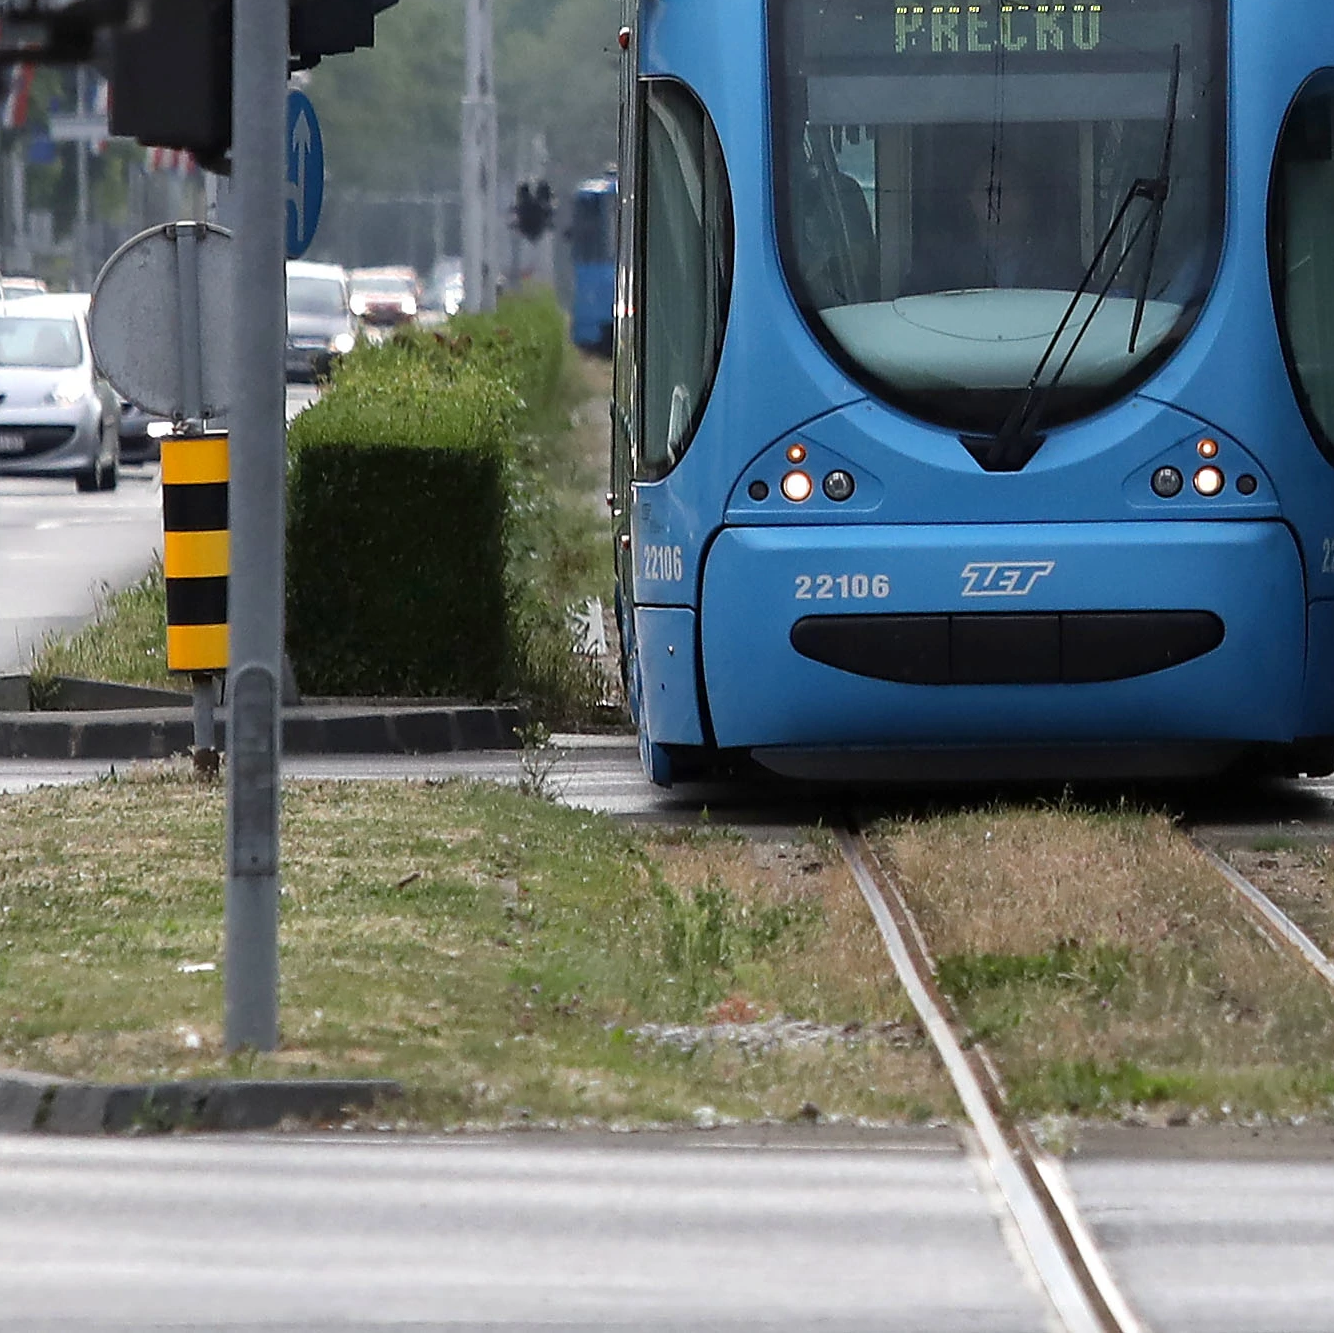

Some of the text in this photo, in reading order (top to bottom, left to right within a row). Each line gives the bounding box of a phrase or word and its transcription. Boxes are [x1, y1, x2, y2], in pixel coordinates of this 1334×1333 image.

[643, 544, 683, 582] 22106
[960, 560, 1055, 597] ZET
[794, 574, 891, 600] 22106
